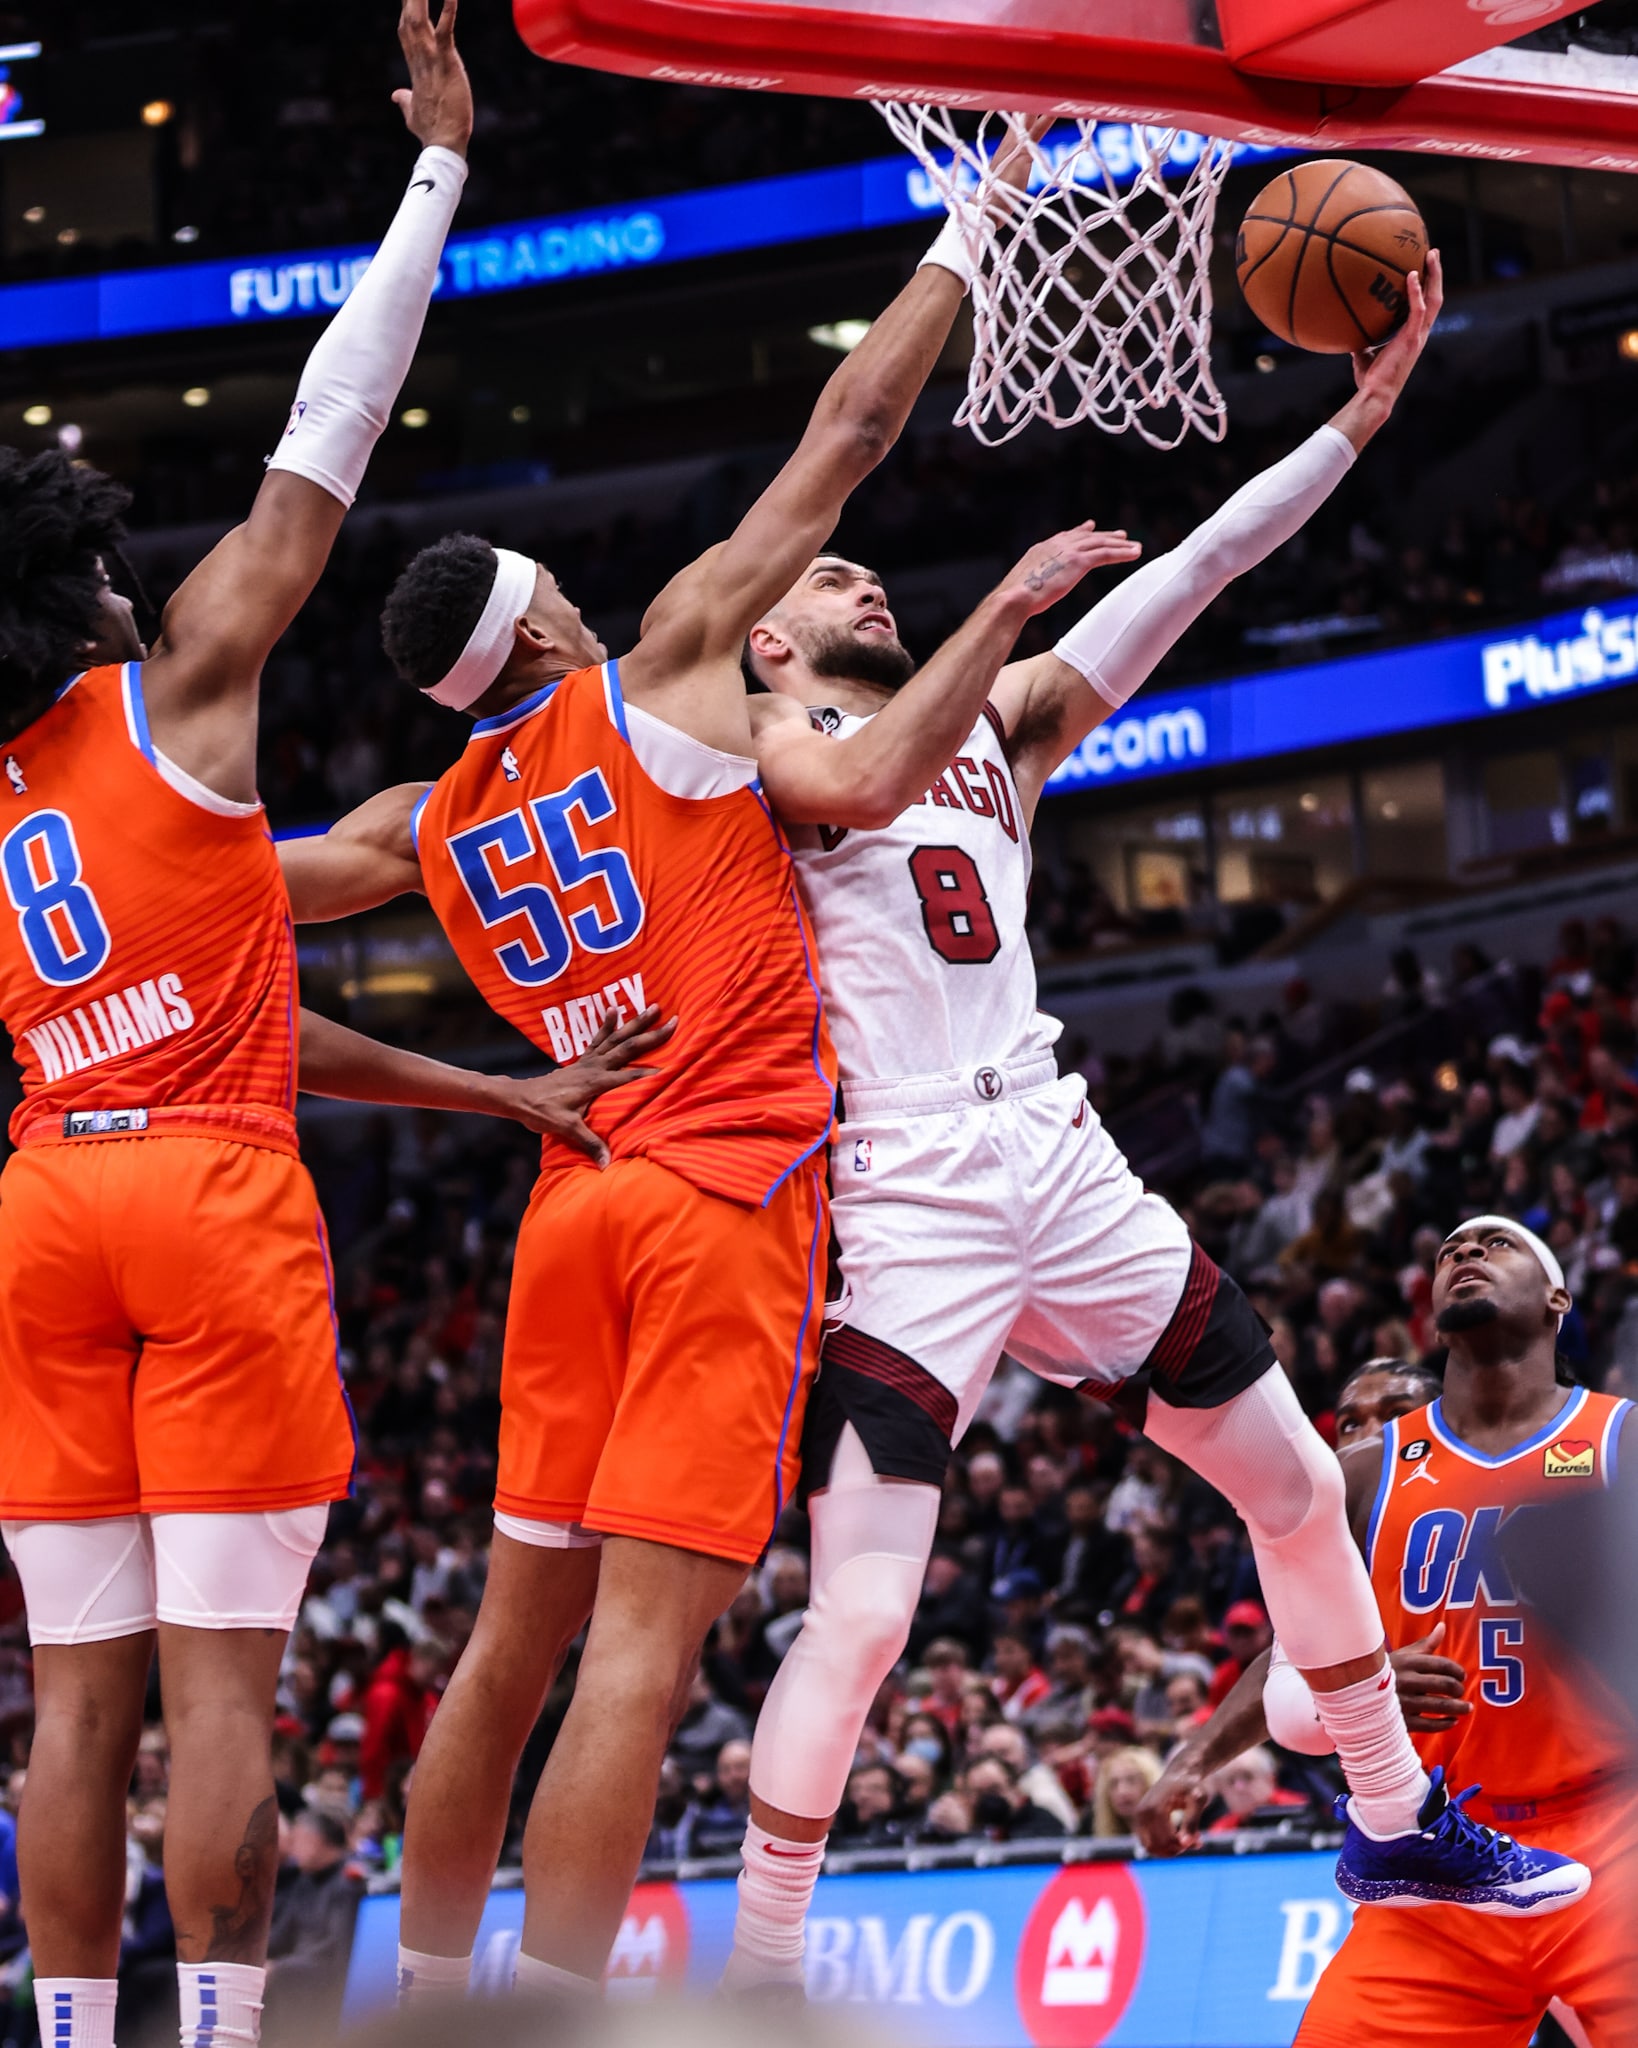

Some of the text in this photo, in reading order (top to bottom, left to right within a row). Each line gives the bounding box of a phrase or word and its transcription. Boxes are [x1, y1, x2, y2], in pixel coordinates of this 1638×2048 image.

[650, 66, 783, 89] betway
[854, 84, 984, 106] betway
[1050, 100, 1174, 121] betway
[1416, 139, 1532, 159] betway
[1482, 608, 1638, 708] Plus5
[1, 808, 111, 987] 8
[446, 766, 645, 987] 55
[908, 845, 1001, 964] 8
[22, 973, 195, 1083] WILLIAMS
[1405, 1441, 1427, 1460] 6
[1400, 1504, 1542, 1614] OK
[1479, 1618, 1525, 1707] 5
[805, 1911, 996, 2006] BMO
